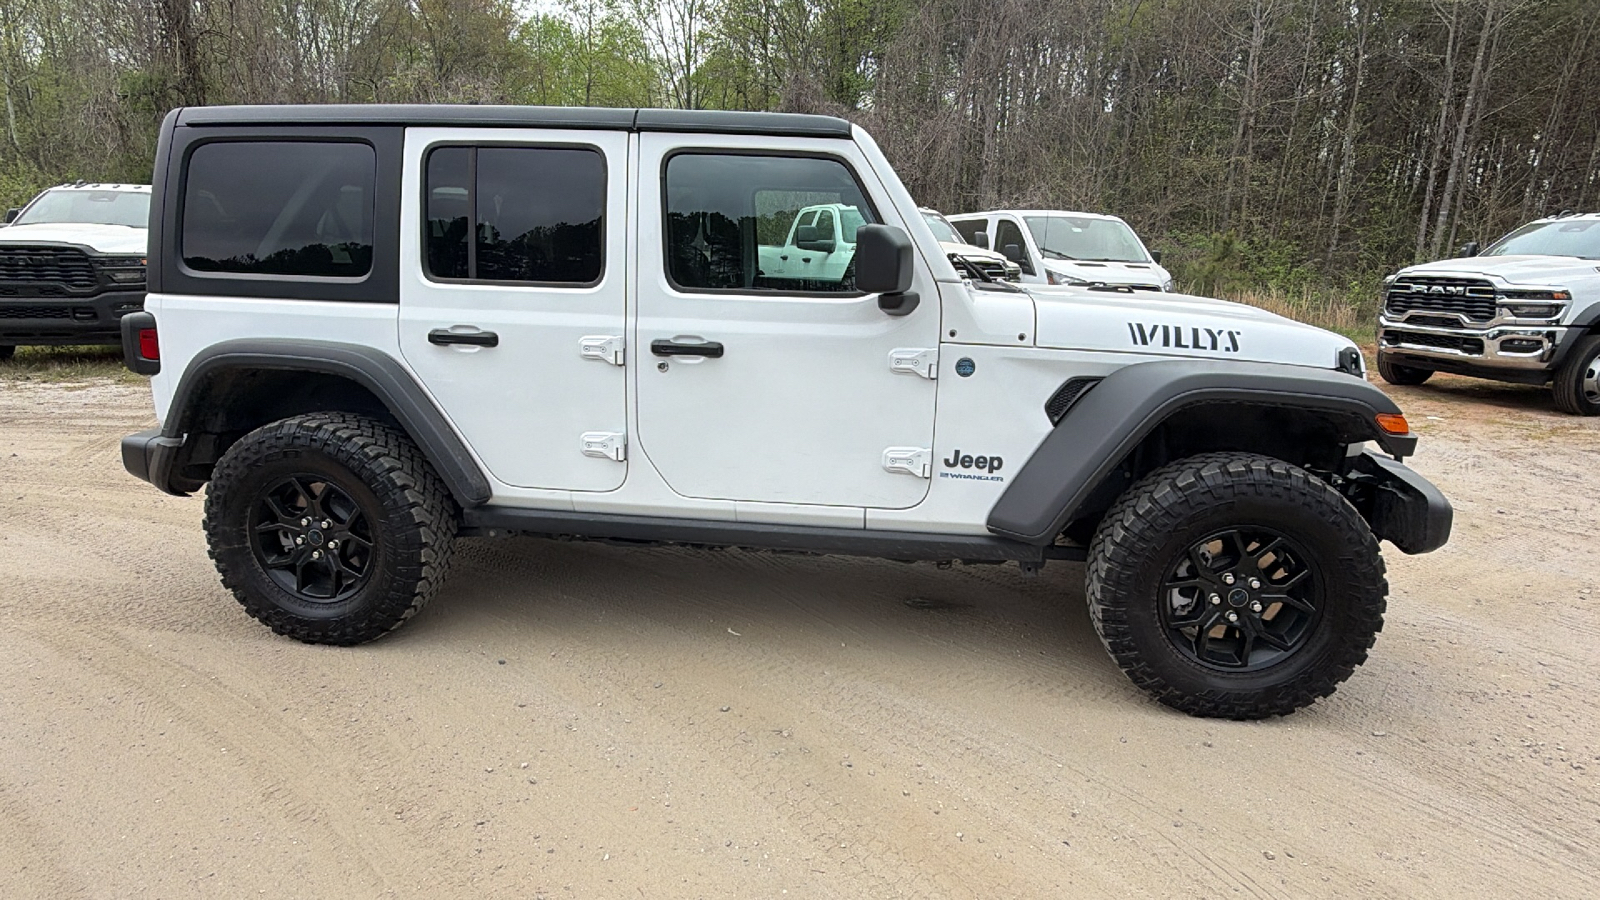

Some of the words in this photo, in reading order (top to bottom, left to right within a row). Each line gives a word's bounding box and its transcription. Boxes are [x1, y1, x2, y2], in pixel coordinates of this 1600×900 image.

[1411, 284, 1465, 295] RAM
[1127, 322, 1241, 352] WILLYS
[943, 449, 1003, 473] Jeep
[950, 472, 1004, 482] WRANGLER
